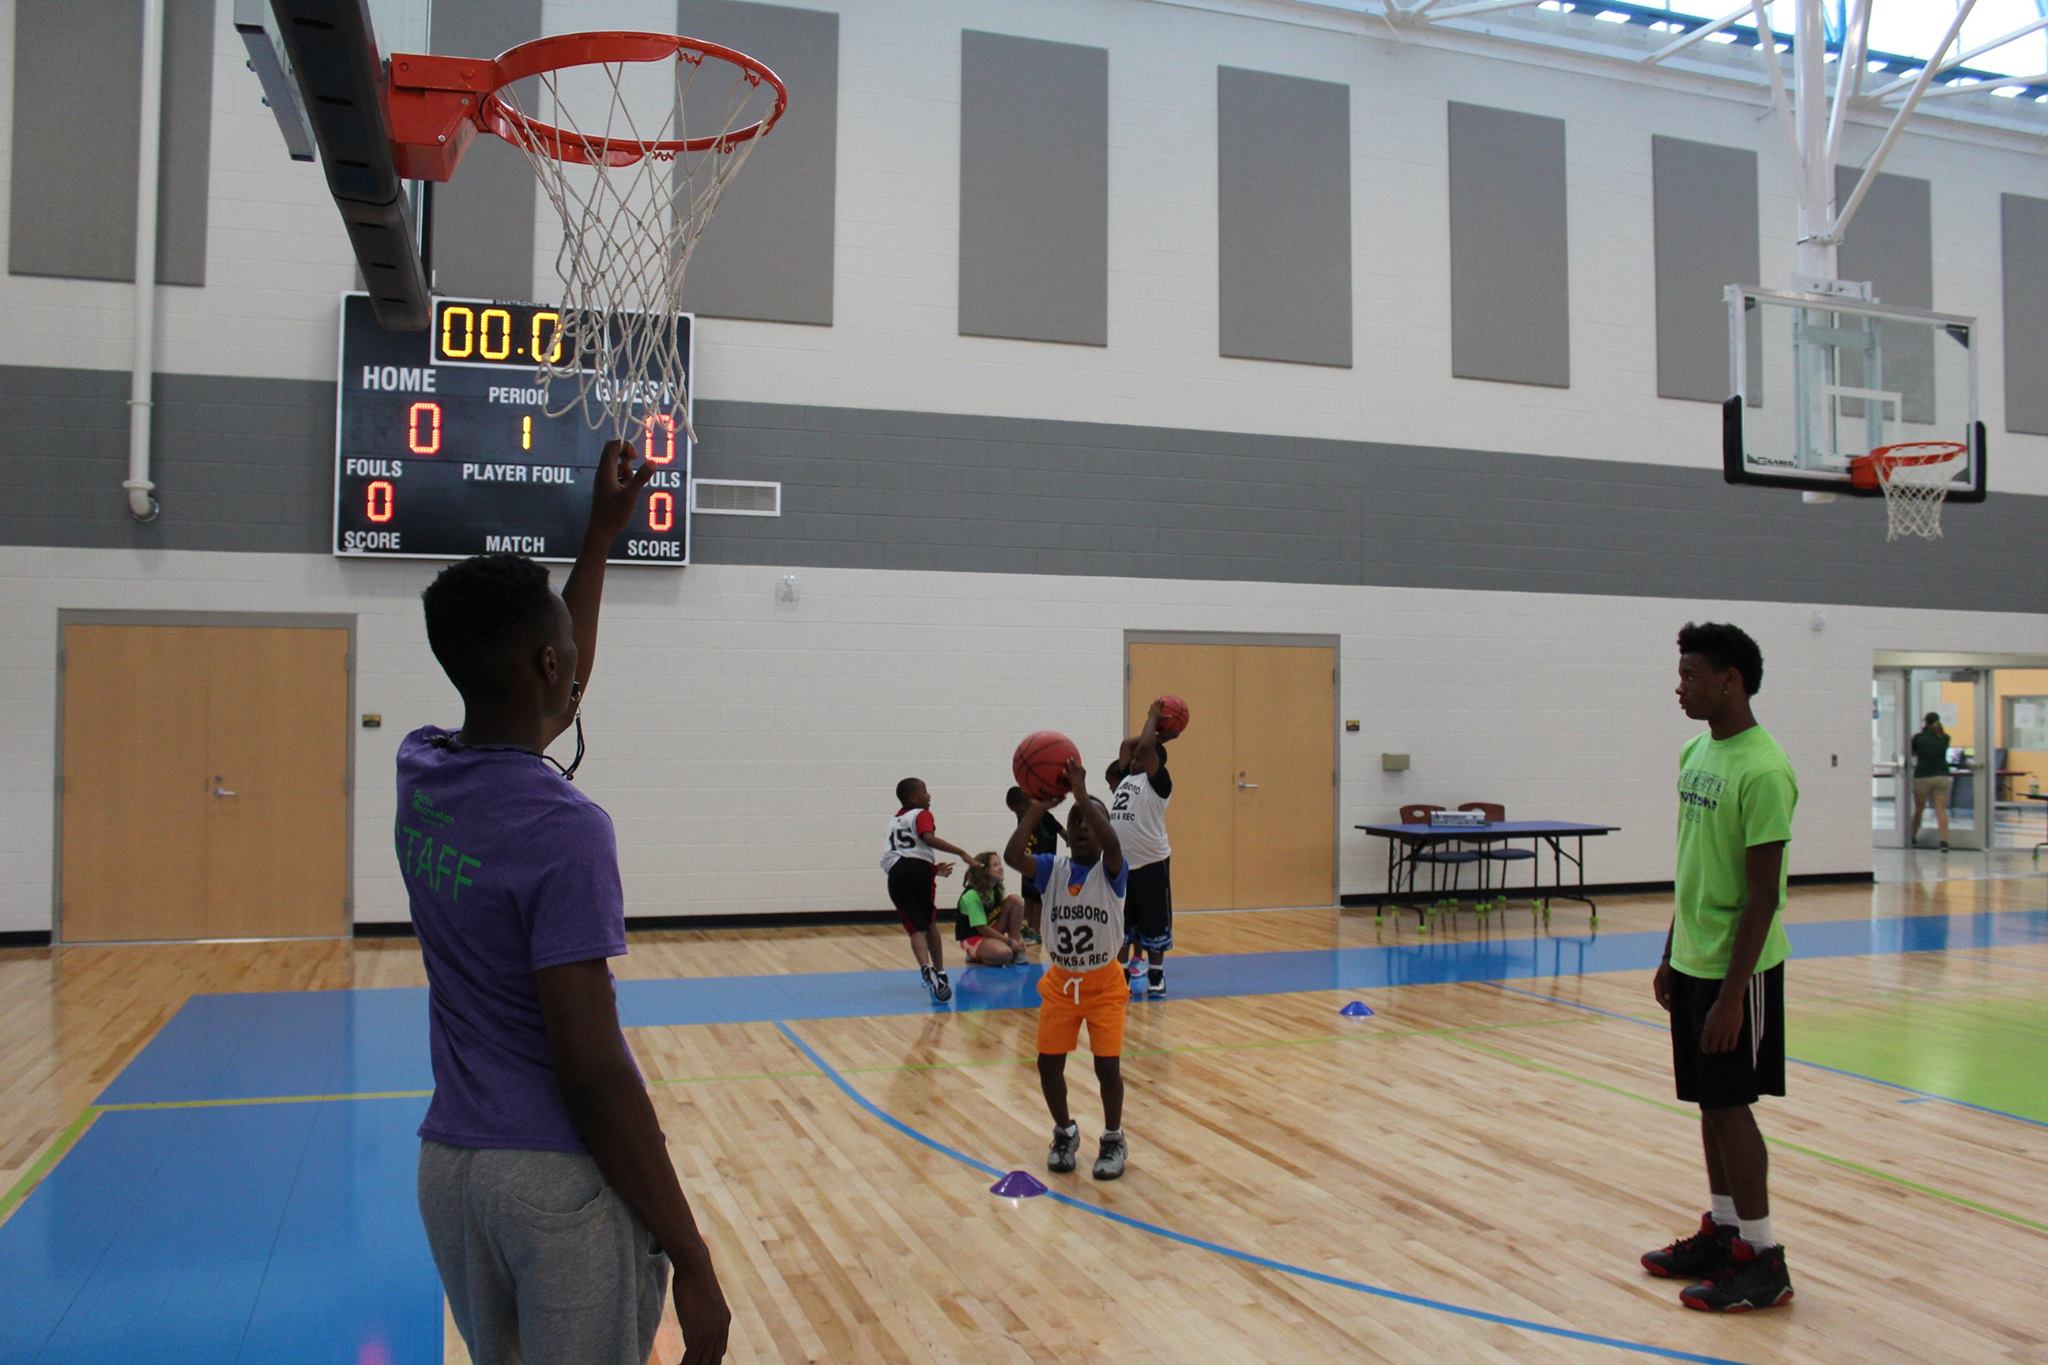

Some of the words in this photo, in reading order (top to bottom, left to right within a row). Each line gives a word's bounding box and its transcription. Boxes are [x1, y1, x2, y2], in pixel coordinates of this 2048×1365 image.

[442, 306, 562, 364] 00.0
[362, 366, 437, 393] HOME
[595, 378, 674, 405] GUEST
[488, 386, 550, 405] PERIOD
[408, 402, 441, 455] 0
[521, 415, 533, 451] 1
[645, 414, 676, 464] 0
[346, 458, 403, 477] FOULS
[462, 463, 527, 483] PLAYER
[532, 466, 575, 485] FOUL
[633, 470, 681, 488] ULS
[366, 481, 395, 523] 0
[649, 492, 674, 532] 0
[344, 531, 402, 550] SCORE
[485, 535, 546, 553] MATCH
[628, 540, 681, 558] SCORE
[888, 827, 916, 851] 15
[397, 825, 482, 903] TAFF
[1056, 925, 1094, 955] 32
[1050, 951, 1078, 967] PRKS
